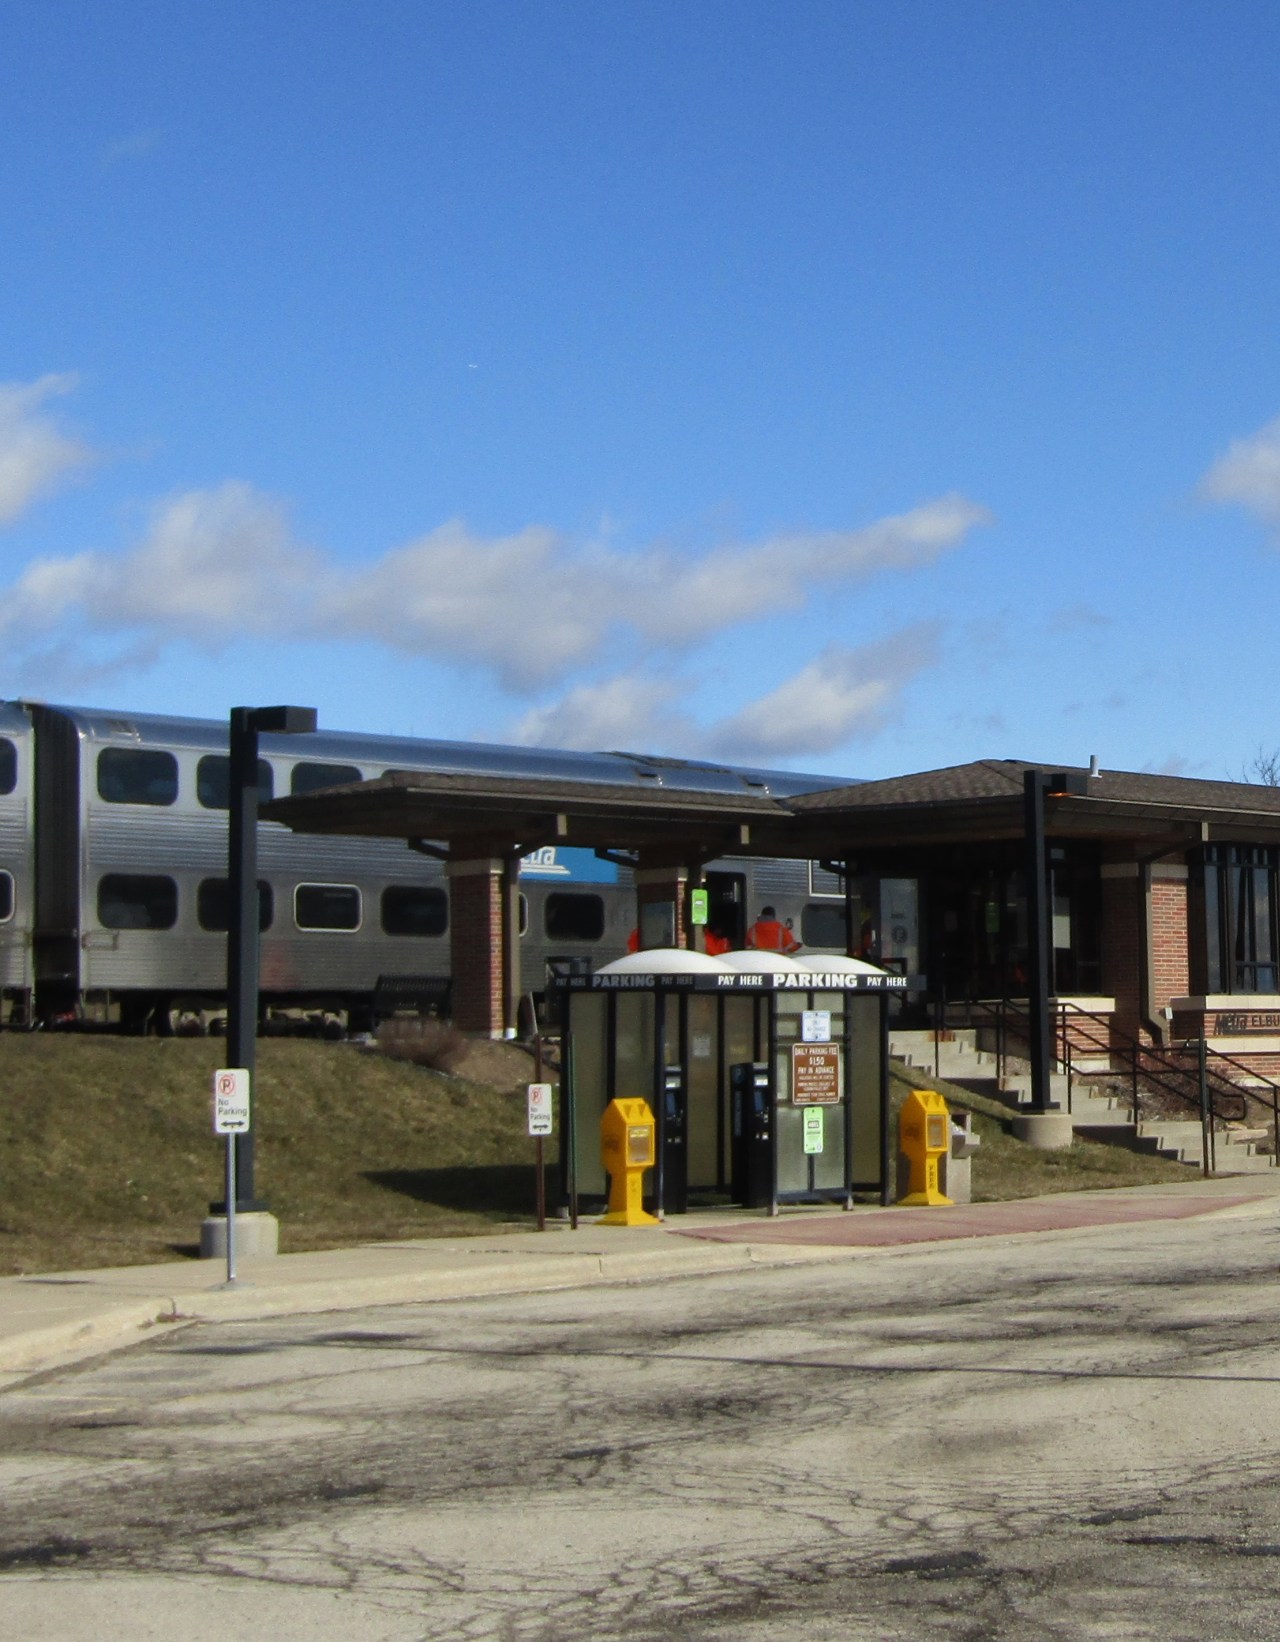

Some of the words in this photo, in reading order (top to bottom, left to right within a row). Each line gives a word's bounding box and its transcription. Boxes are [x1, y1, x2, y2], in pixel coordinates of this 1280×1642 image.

[556, 977, 567, 986] PAY
[592, 975, 655, 987] PARKING
[661, 975, 673, 985] PAY
[676, 975, 693, 985] HERE
[718, 975, 735, 986] PAY
[739, 975, 763, 986] HERE
[772, 974, 858, 988] PARKING
[866, 976, 882, 987] PAY
[886, 976, 908, 987] HERE
[794, 1047, 808, 1056] DAILY
[809, 1047, 828, 1055] PARKING
[828, 1047, 838, 1055] FEE
[797, 1066, 807, 1075] PAY
[815, 1066, 835, 1075] ADVANCE
[218, 1098, 229, 1106] No
[218, 1106, 248, 1117] Parking
